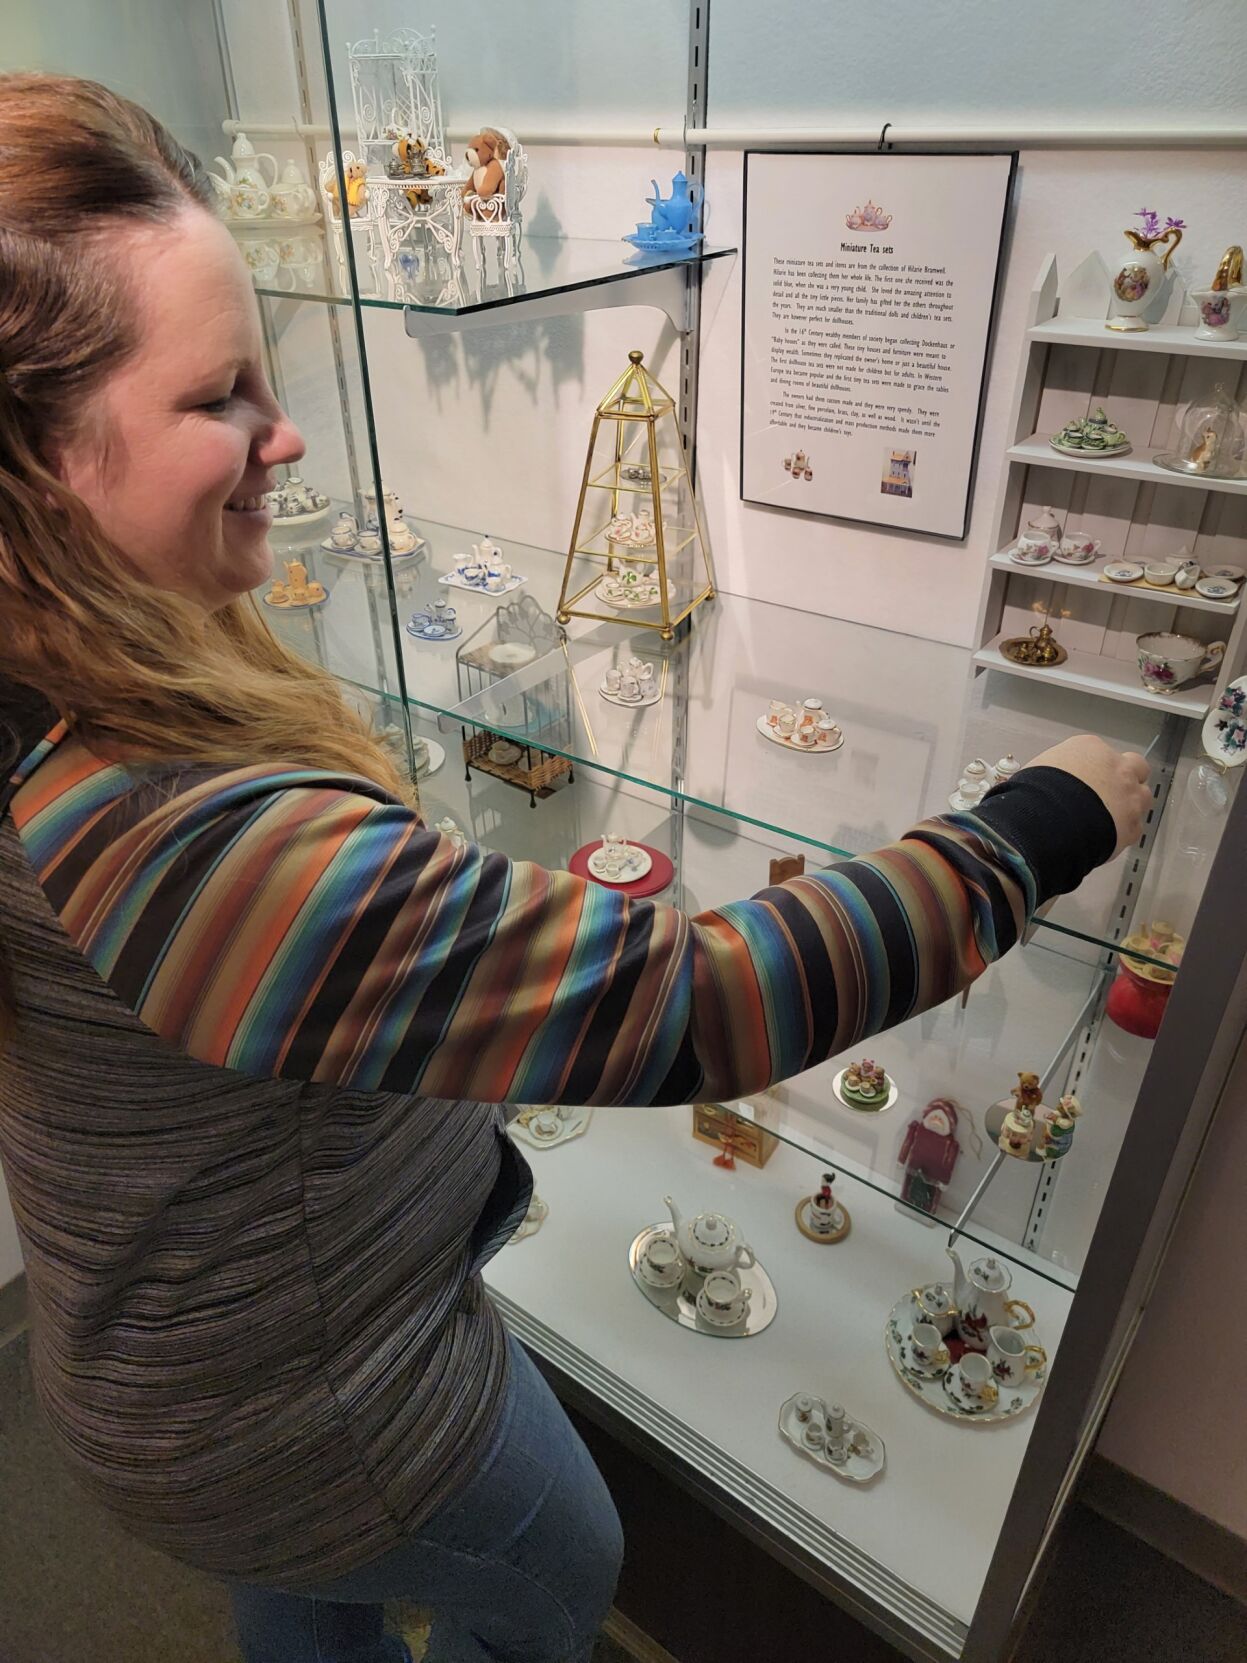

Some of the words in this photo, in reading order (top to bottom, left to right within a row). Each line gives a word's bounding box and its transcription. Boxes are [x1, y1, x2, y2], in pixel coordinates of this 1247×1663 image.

[840, 242, 867, 252] Miniature
[870, 243, 880, 253] Tea
[882, 245, 894, 254] sets
[878, 263, 899, 271] collection
